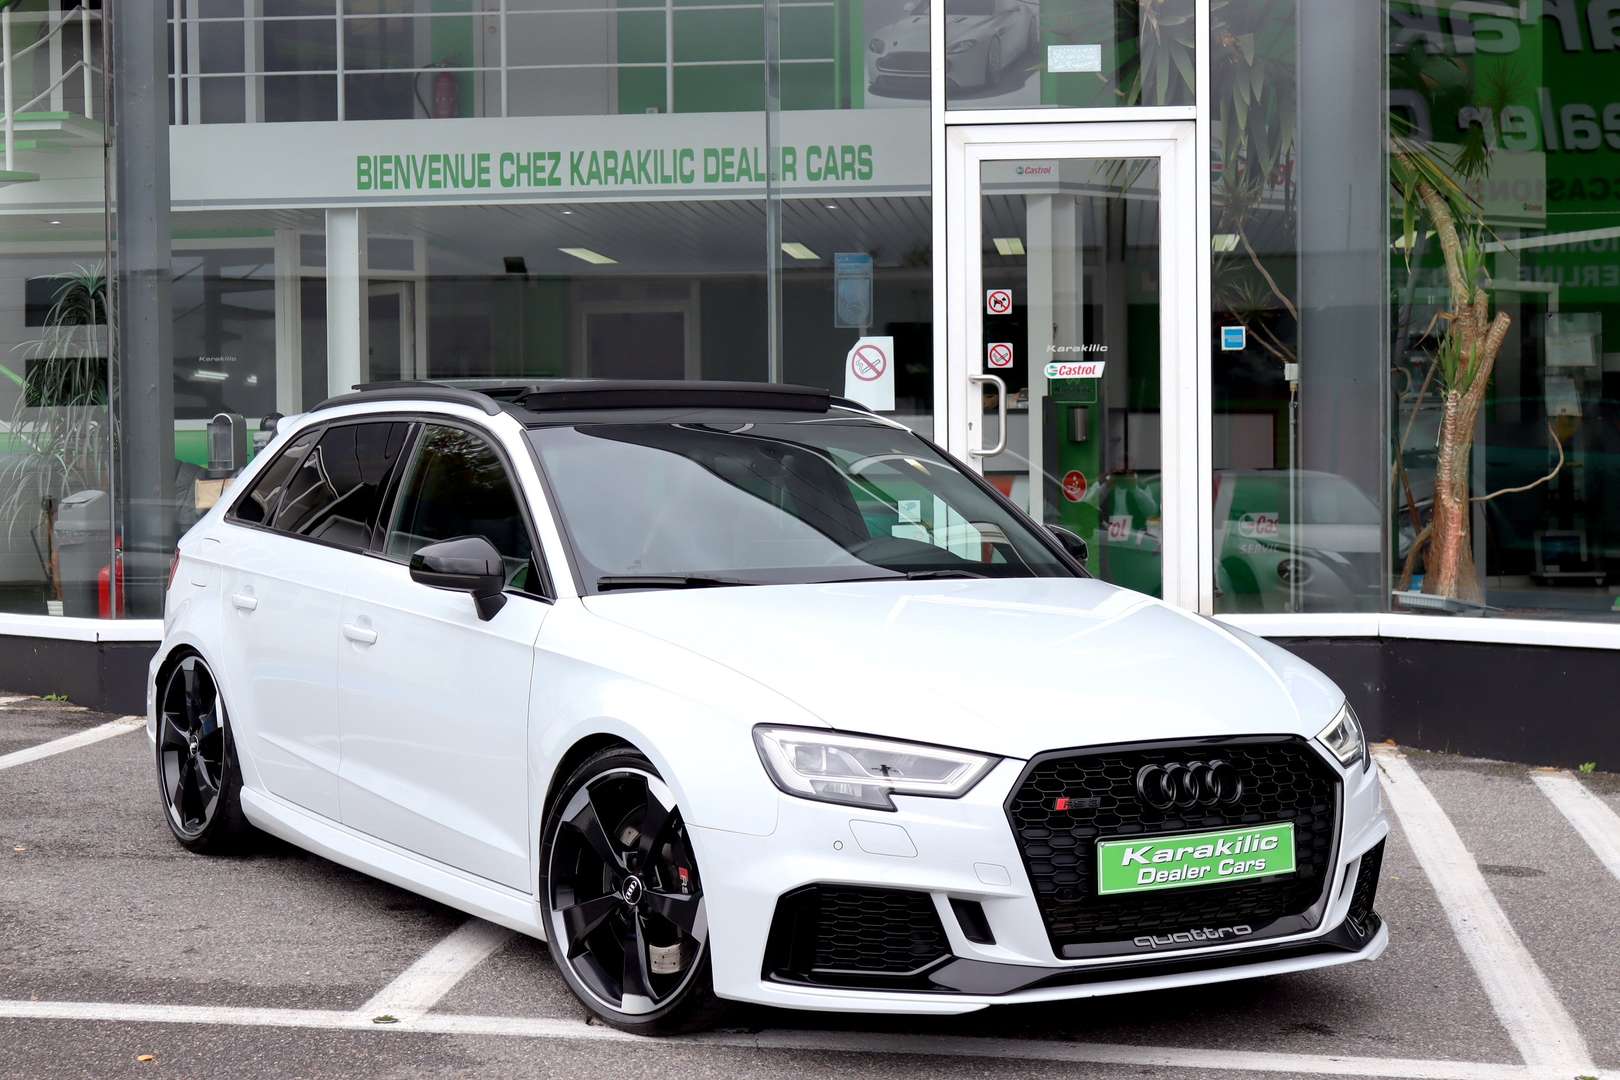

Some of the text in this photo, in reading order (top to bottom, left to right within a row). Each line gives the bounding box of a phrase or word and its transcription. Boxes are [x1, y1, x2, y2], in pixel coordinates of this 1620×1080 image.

[356, 144, 873, 191] BIENVENUE CHEZ KARAKILIC DEALR CARS
[1024, 166, 1052, 175] Castrol
[1046, 343, 1109, 353] Karakilic
[1058, 365, 1097, 376] Castrol
[1121, 834, 1279, 867] Karakilic
[1136, 858, 1267, 885] Dealer Cars
[1133, 924, 1253, 948] quattro
